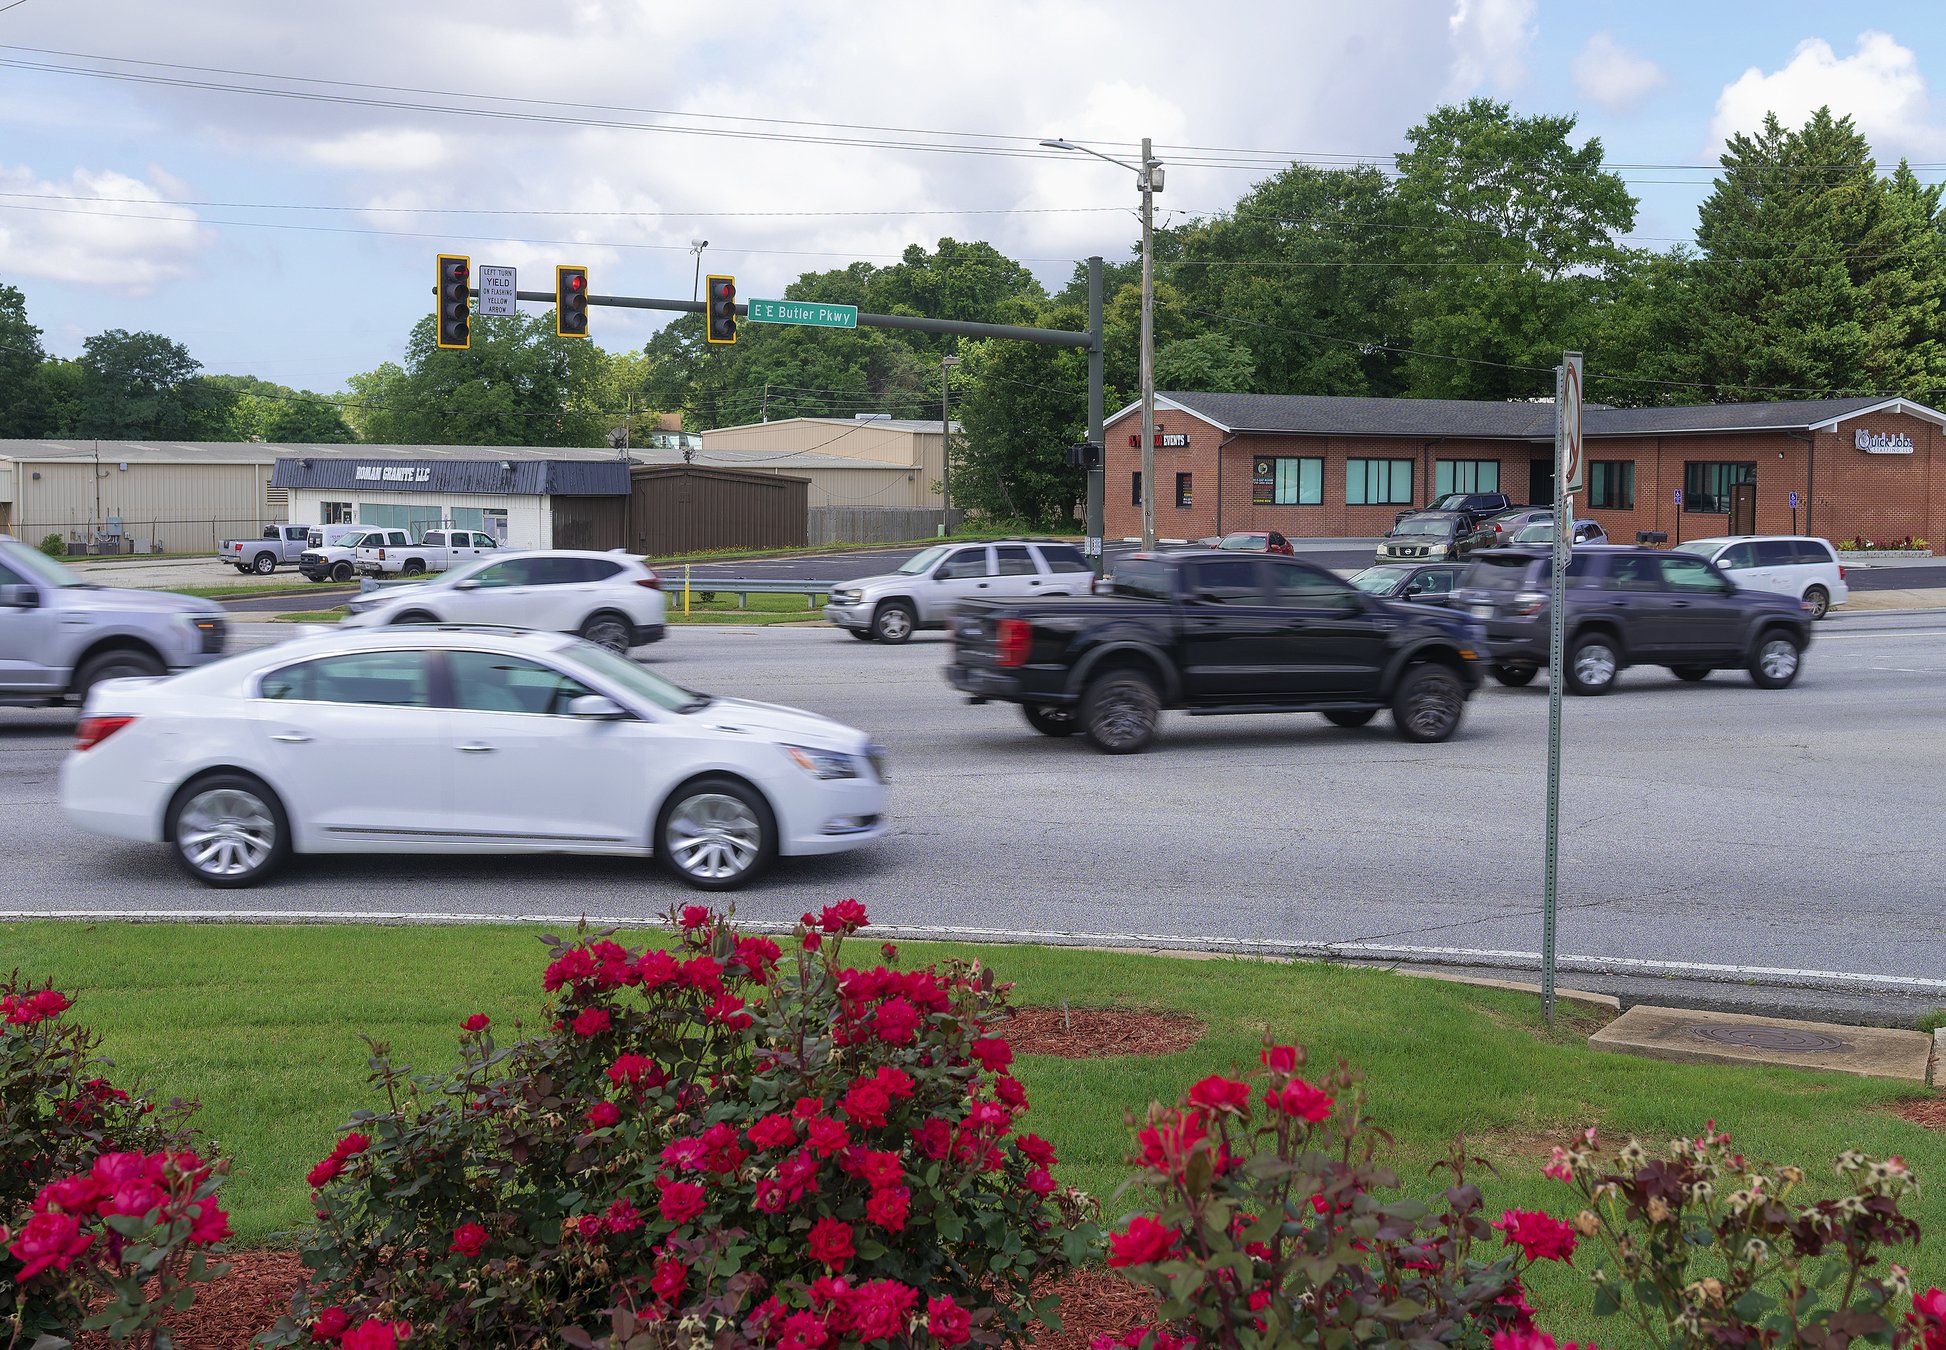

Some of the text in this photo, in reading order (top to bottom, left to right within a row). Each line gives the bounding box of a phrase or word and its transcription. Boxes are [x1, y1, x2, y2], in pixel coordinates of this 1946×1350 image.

[487, 278, 510, 286] YIELD
[755, 304, 762, 316] E
[779, 306, 814, 319] Butler
[820, 309, 850, 324] Pkwy
[1164, 434, 1184, 446] EVENTS
[1859, 432, 1912, 452] Quick Jobs
[356, 466, 430, 482] ROMAN GRANITE LLC
